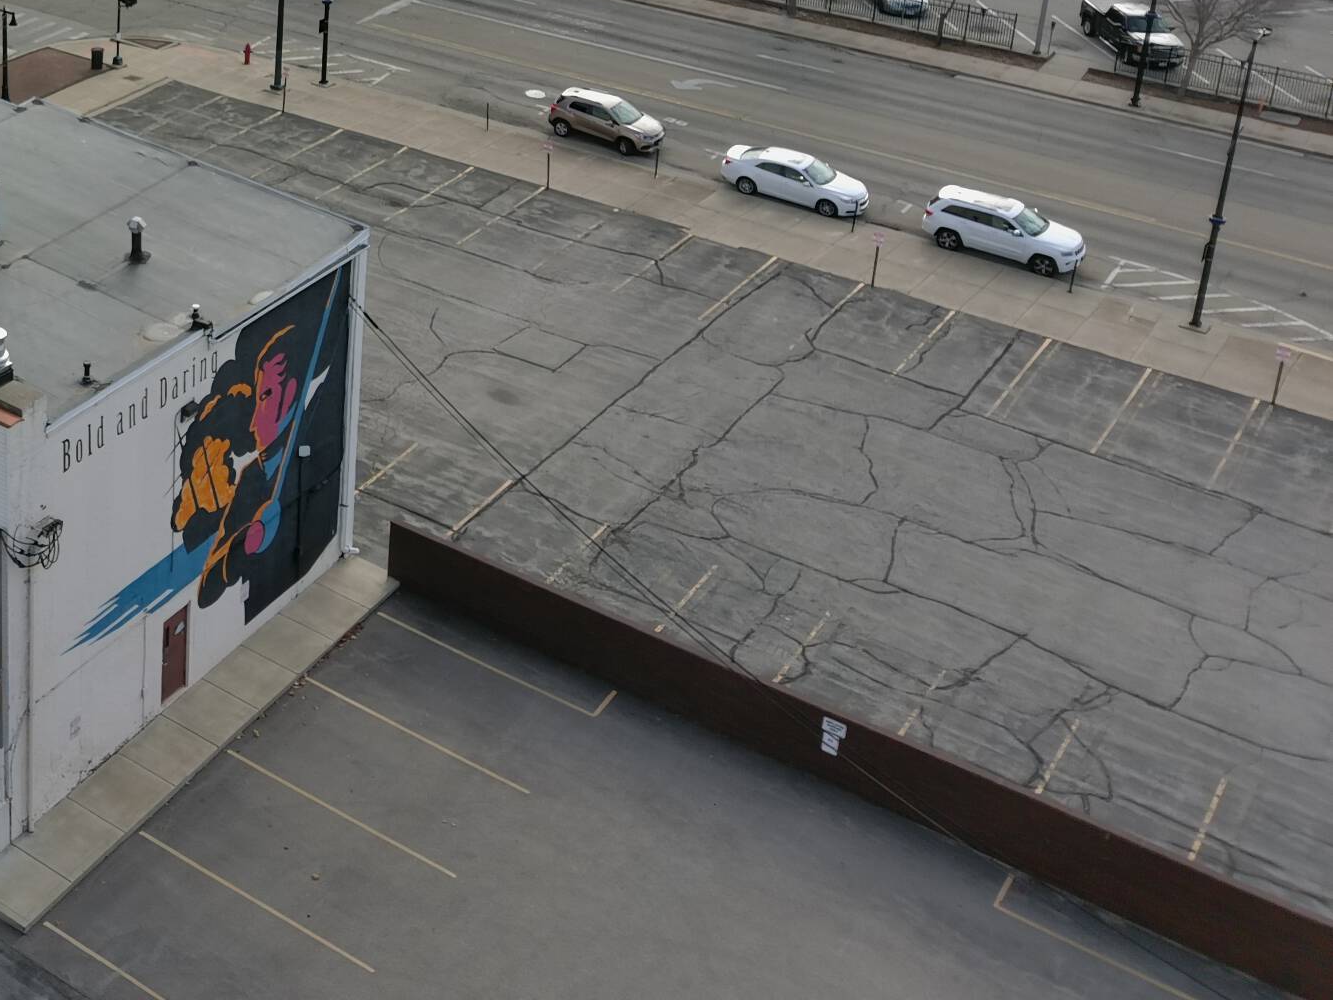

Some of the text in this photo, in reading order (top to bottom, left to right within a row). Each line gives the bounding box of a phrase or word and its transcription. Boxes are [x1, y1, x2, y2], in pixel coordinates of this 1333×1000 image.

[62, 350, 219, 473] Bold and Daring
